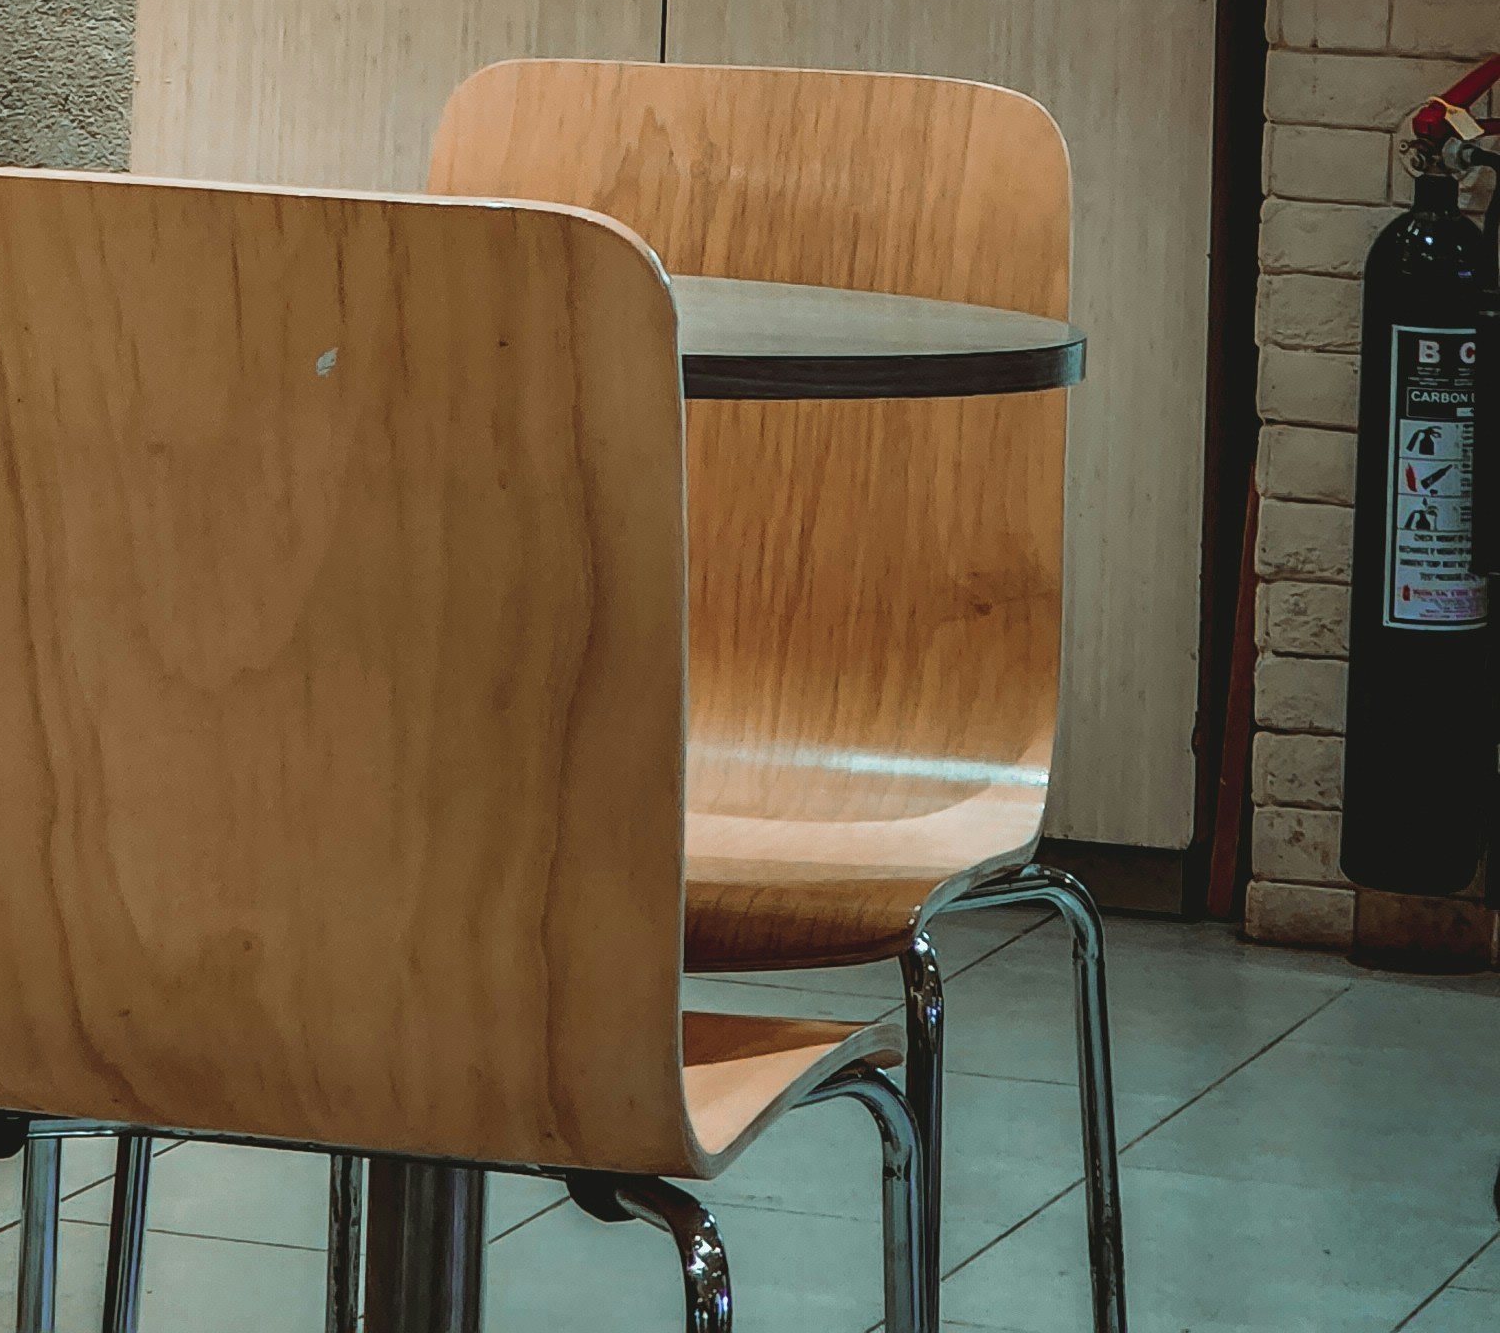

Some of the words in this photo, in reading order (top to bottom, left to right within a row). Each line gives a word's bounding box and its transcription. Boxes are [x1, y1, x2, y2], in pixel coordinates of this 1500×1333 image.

[1418, 339, 1441, 364] B
[1459, 341, 1477, 364] C
[1411, 390, 1469, 404] CARBON
